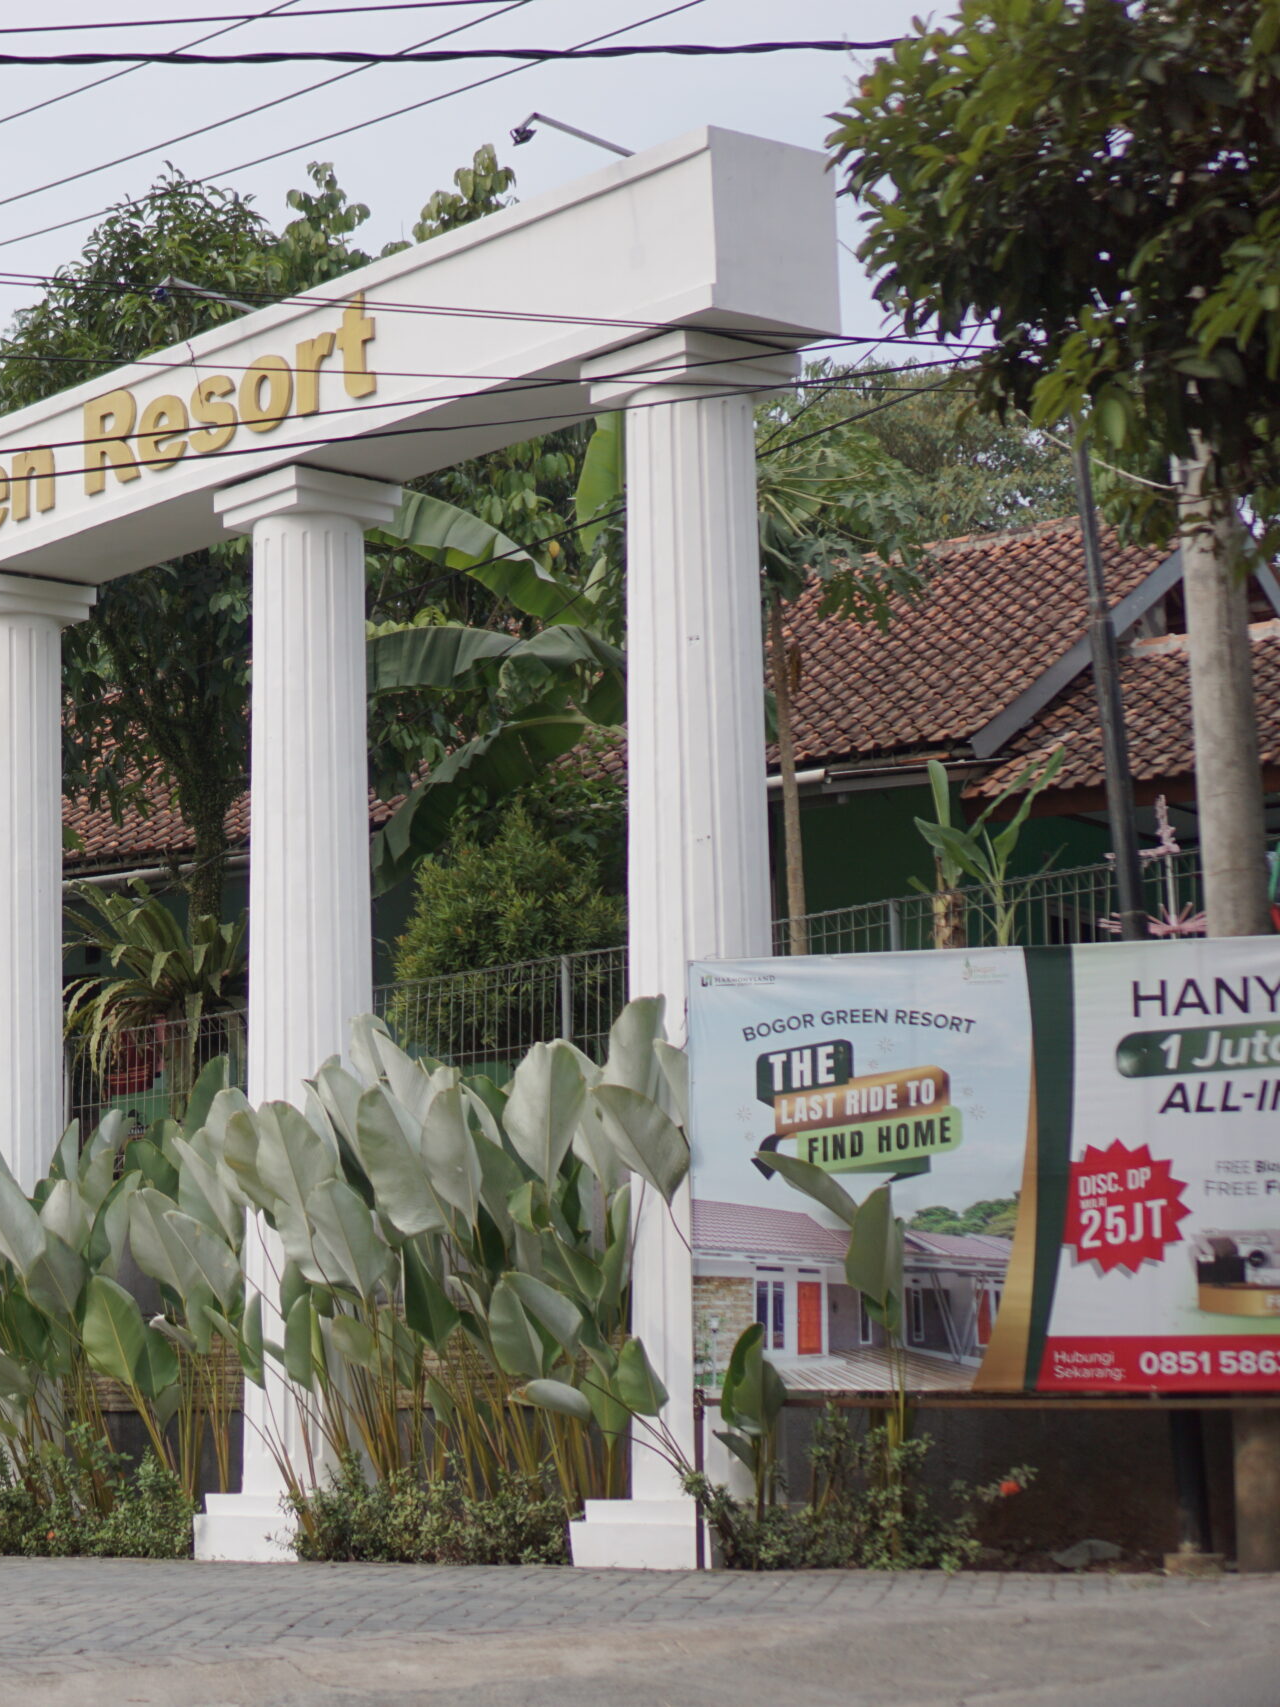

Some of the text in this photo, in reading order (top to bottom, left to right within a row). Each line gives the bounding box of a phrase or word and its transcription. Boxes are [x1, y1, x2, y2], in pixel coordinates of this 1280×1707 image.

[83, 293, 378, 497] Resort
[1132, 976, 1280, 1017] HANY
[742, 1008, 976, 1042] BOGOR GREEN RESORT
[768, 1045, 836, 1092] THE
[1159, 1033, 1182, 1070] 1
[780, 1078, 935, 1126] LAST RIDE TO
[808, 1116, 952, 1164] FIND HOME
[1078, 1166, 1151, 1197] DISC. DP
[1204, 1180, 1258, 1196] FREE
[1080, 1198, 1168, 1248] 25JT
[1053, 1351, 1115, 1365] Hubungi
[1053, 1365, 1126, 1381] Sekarang:
[1139, 1350, 1280, 1375] 0851 586
